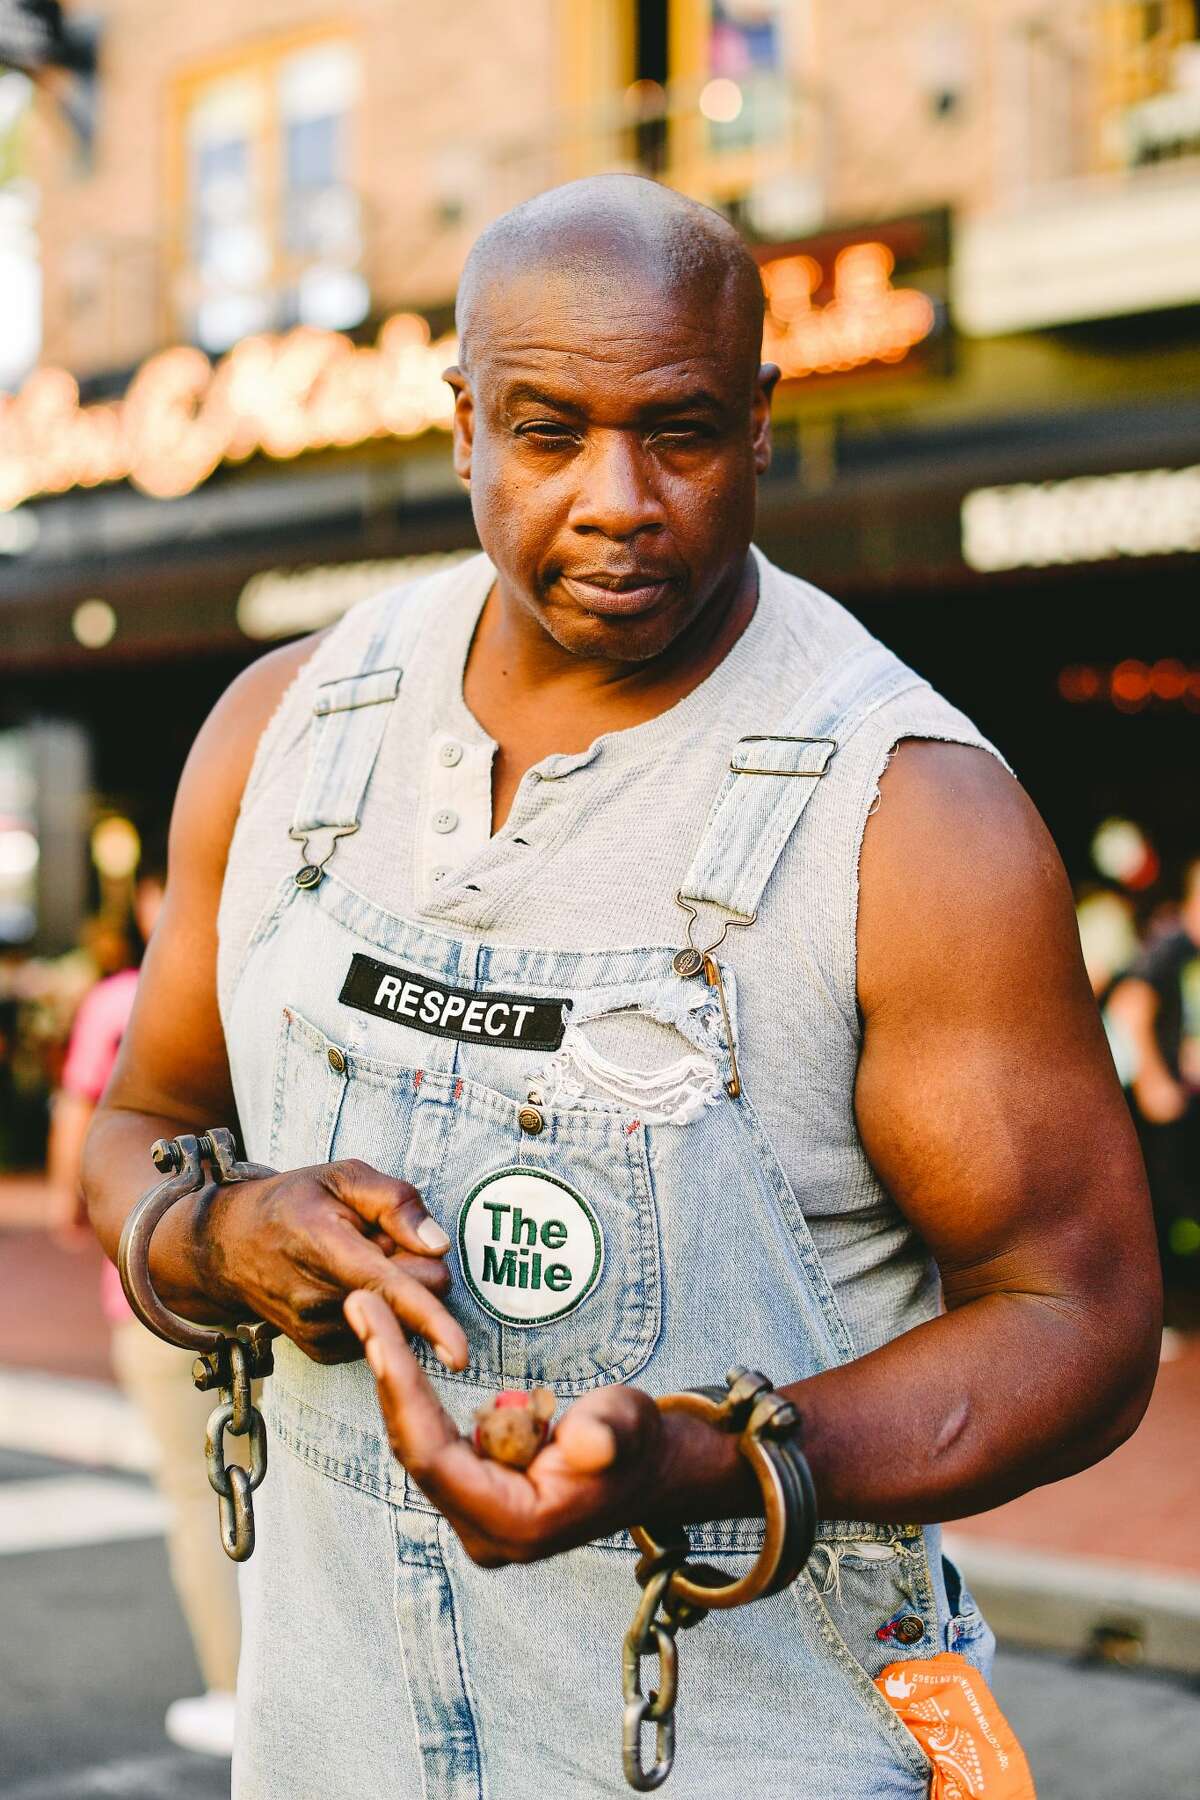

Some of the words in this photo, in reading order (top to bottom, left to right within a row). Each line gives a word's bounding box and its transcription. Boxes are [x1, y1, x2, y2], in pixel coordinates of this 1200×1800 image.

[374, 974, 535, 1037] RESPECT
[483, 1201, 568, 1249] The
[482, 1246, 573, 1291] Mile
[964, 1688, 982, 1717] MADE
[976, 1715, 1001, 1749] COTTON
